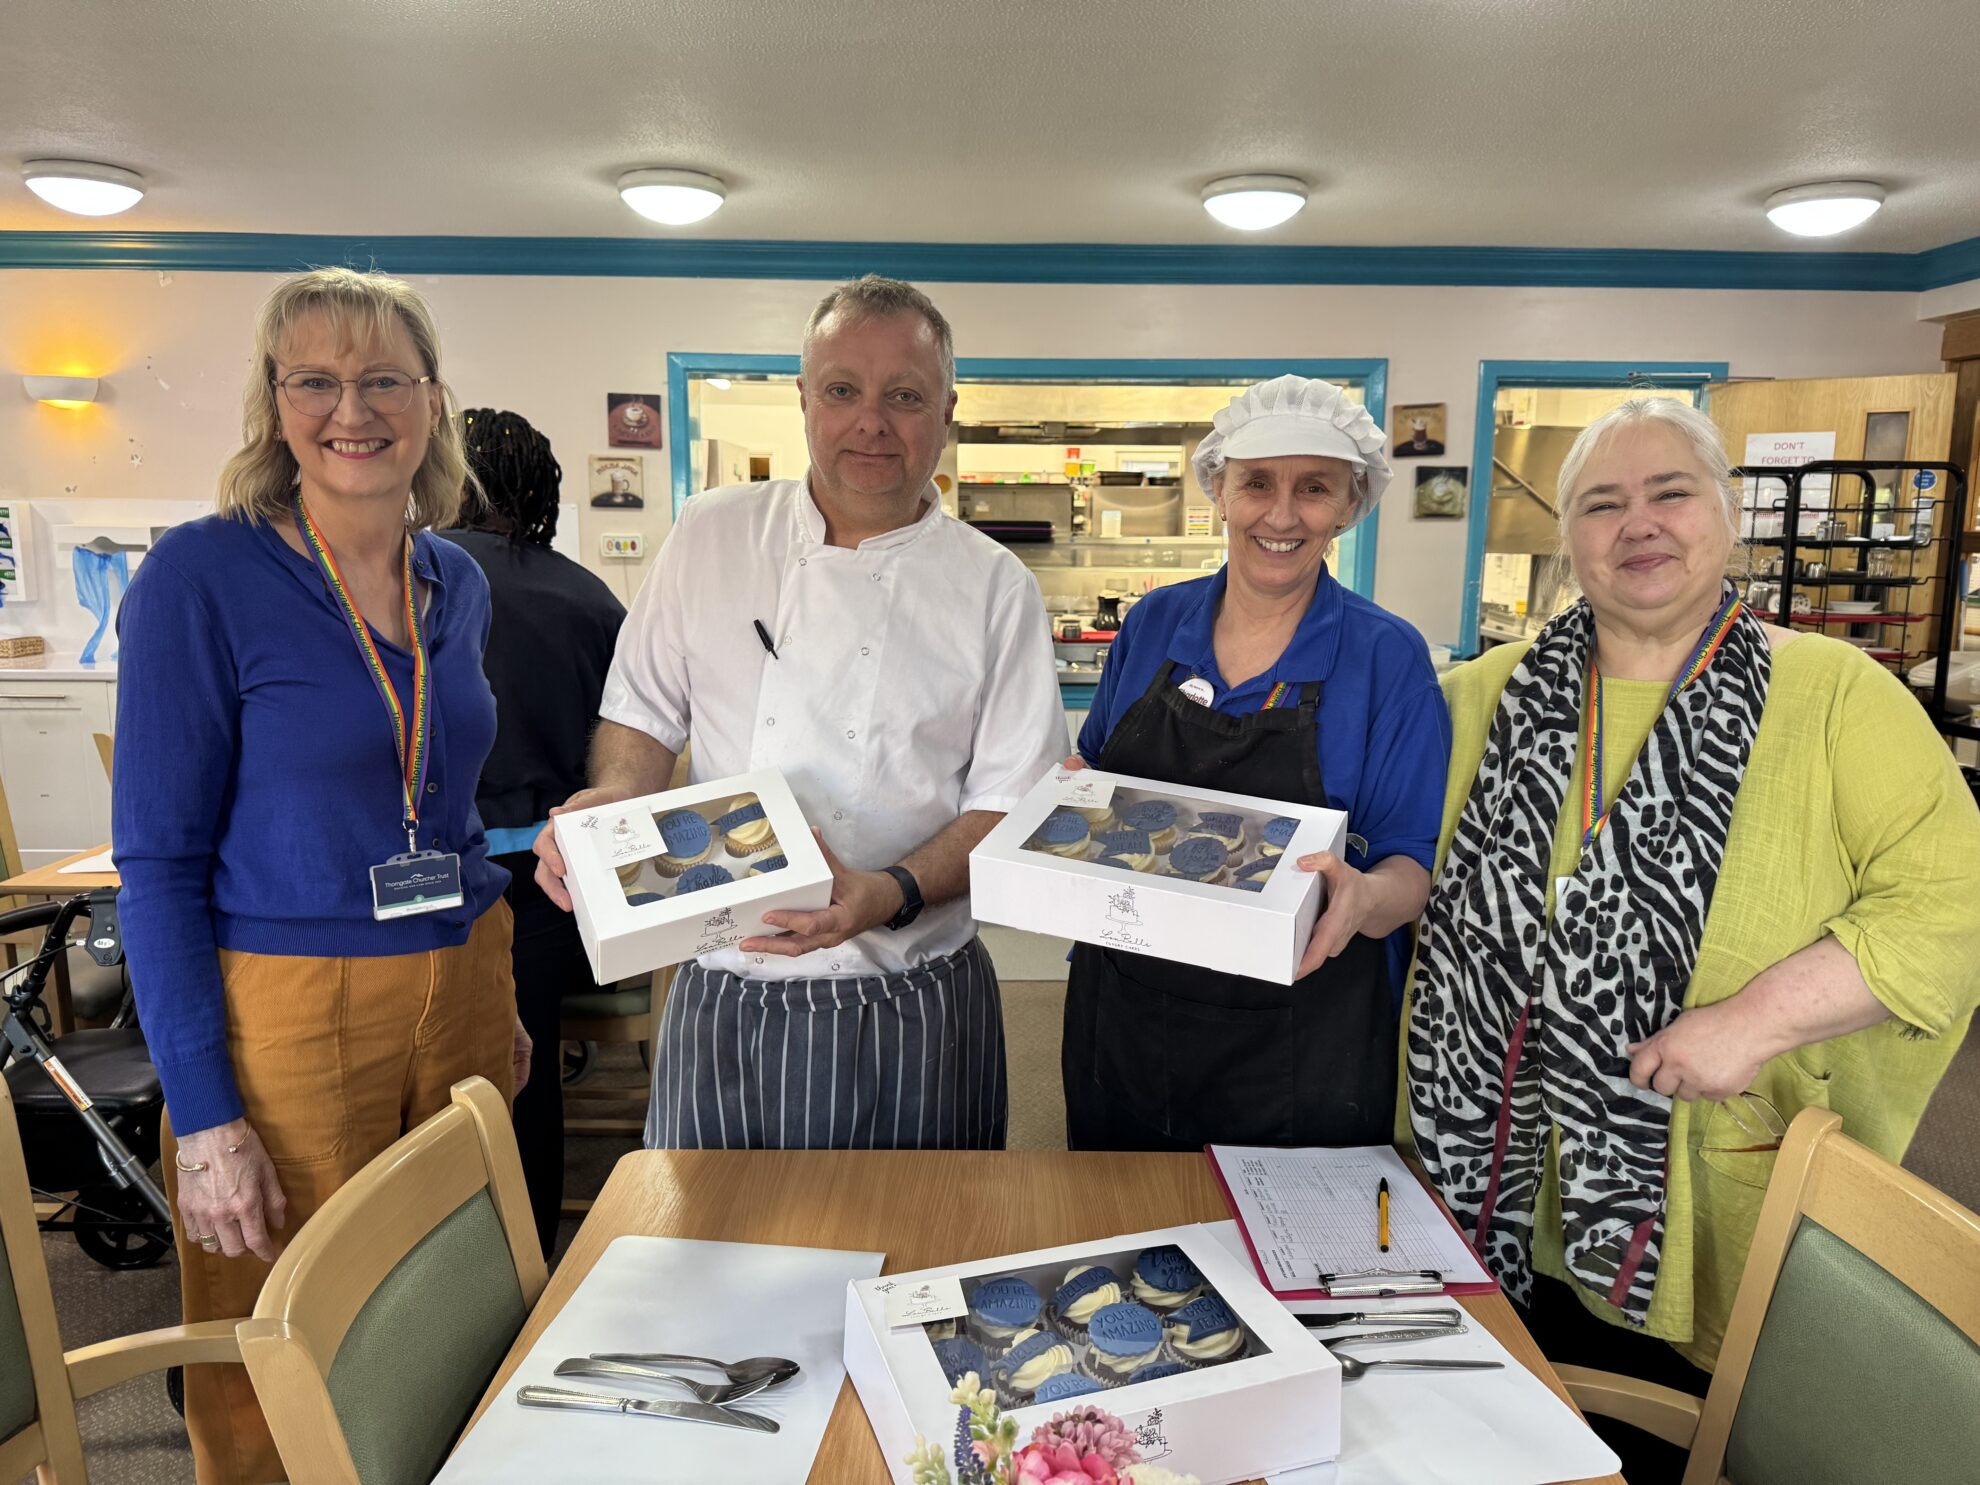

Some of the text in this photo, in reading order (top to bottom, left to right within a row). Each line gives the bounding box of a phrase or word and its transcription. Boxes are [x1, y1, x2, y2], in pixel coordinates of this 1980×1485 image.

[1774, 441, 1805, 451] DON'T
[1761, 456, 1799, 465] FORGET
[332, 577, 386, 683] Thorngate Churcher Trust
[411, 674, 428, 786] Thorngate Churcher Trust
[1589, 753, 1599, 791] Churcher
[384, 879, 412, 888] Thorngate
[412, 875, 436, 884] Churcher
[436, 872, 449, 880] Trust
[1055, 1280, 1089, 1304] WELL
[981, 1298, 1037, 1311] AMAZING
[1095, 1307, 1142, 1329] YOU'RE
[1197, 1310, 1231, 1330] TEAM
[1101, 1318, 1157, 1343] AMAZING
[1002, 1341, 1039, 1367] WELL
